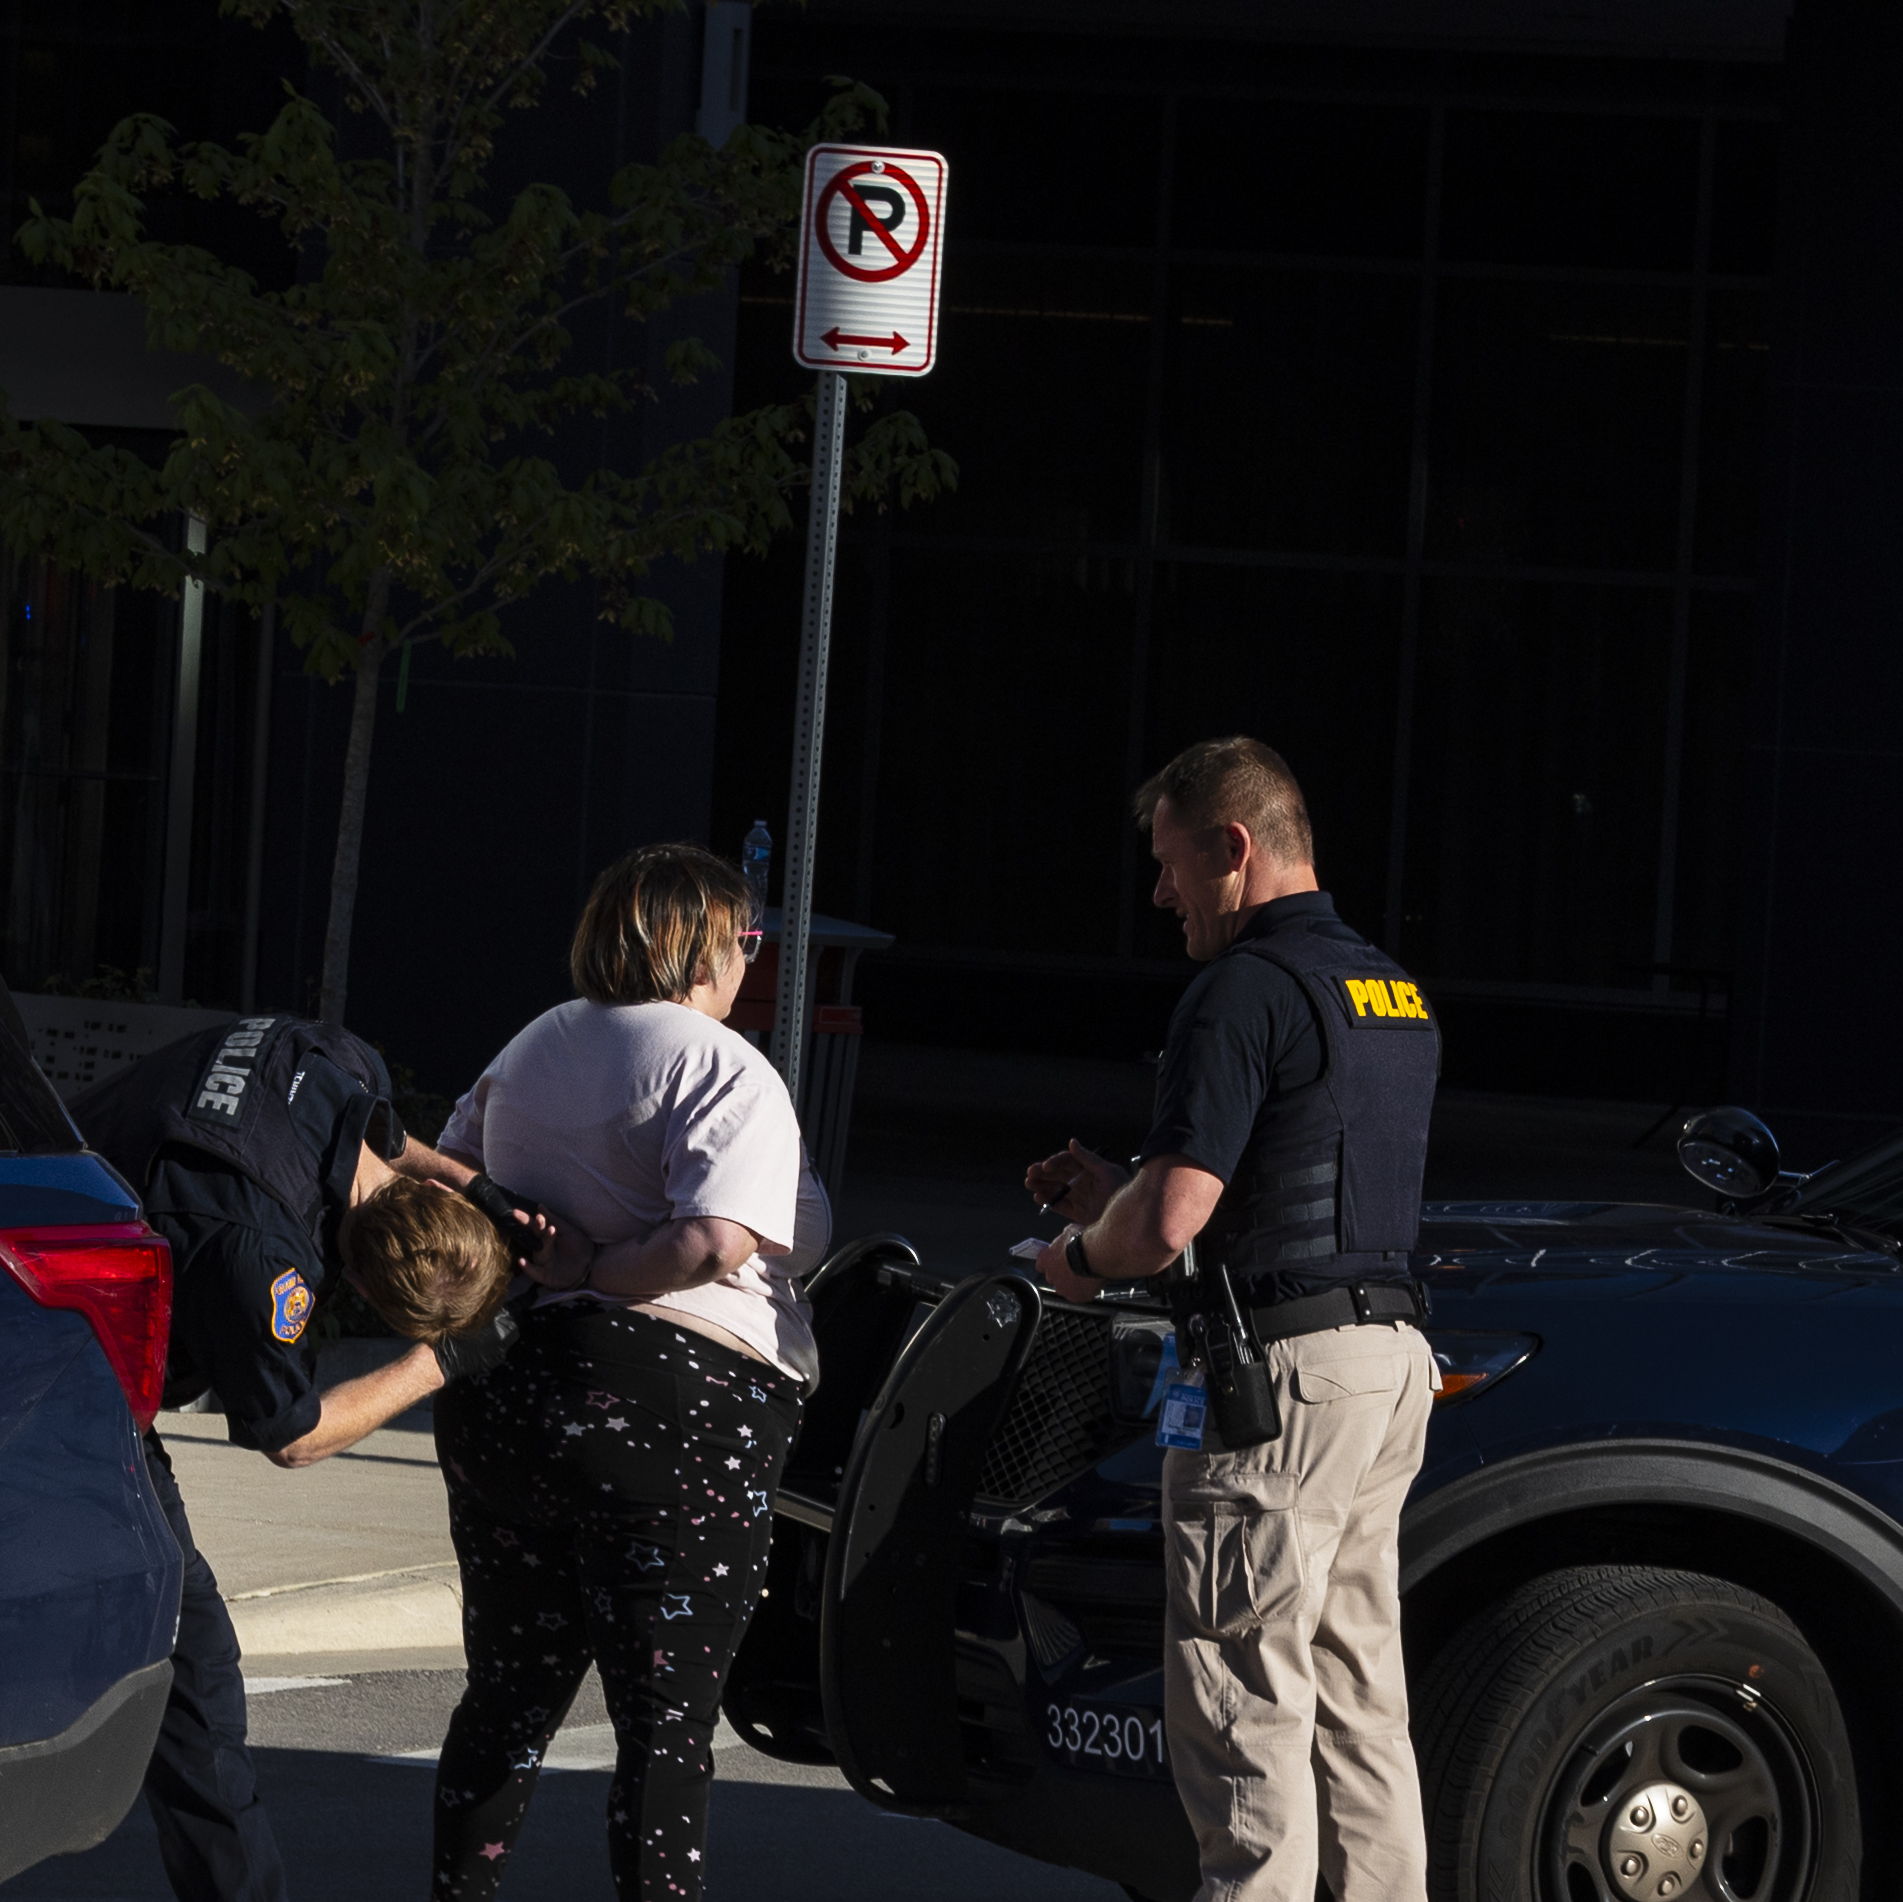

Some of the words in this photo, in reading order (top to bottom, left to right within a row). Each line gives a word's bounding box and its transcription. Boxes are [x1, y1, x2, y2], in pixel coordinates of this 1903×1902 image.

[1344, 978, 1429, 1020] POLICE
[196, 1017, 277, 1116] POLICE
[1046, 1702, 1164, 1764] 332301
